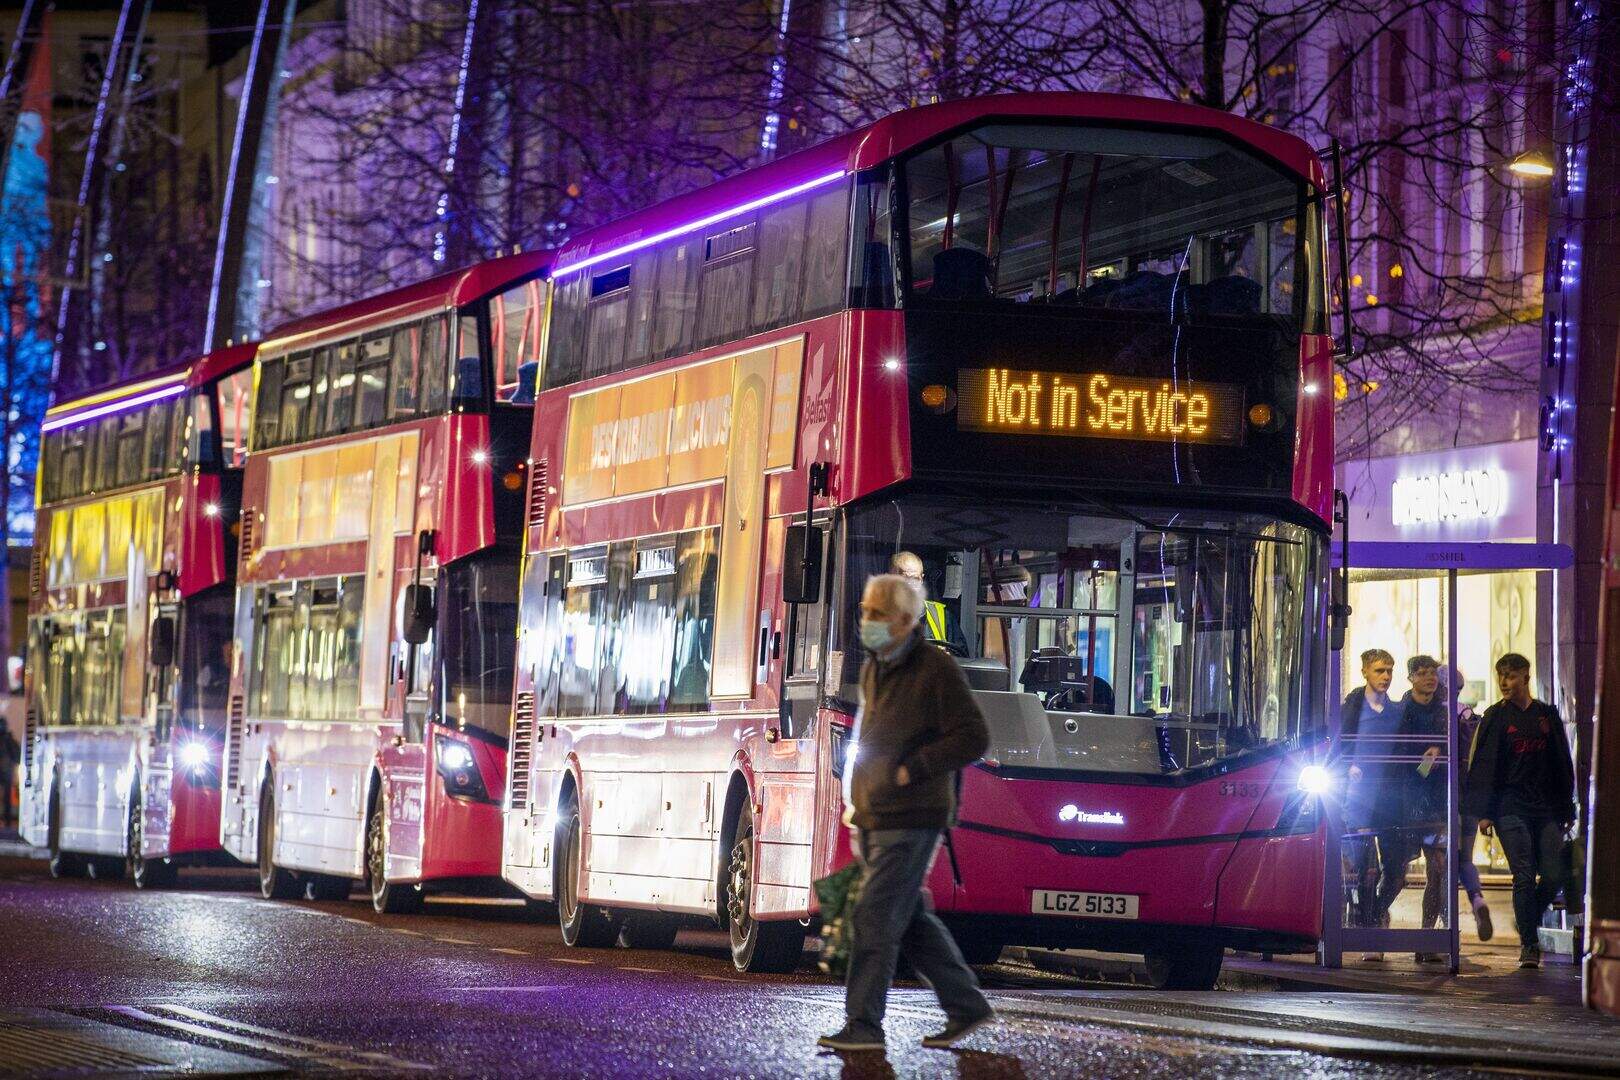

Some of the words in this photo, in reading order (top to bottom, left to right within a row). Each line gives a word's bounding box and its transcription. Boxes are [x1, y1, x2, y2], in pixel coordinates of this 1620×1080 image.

[987, 368, 1041, 424] Not
[1051, 377, 1078, 428] in
[1088, 374, 1209, 435] Service
[1042, 892, 1081, 912] LGZ
[1084, 894, 1128, 915] 5133
